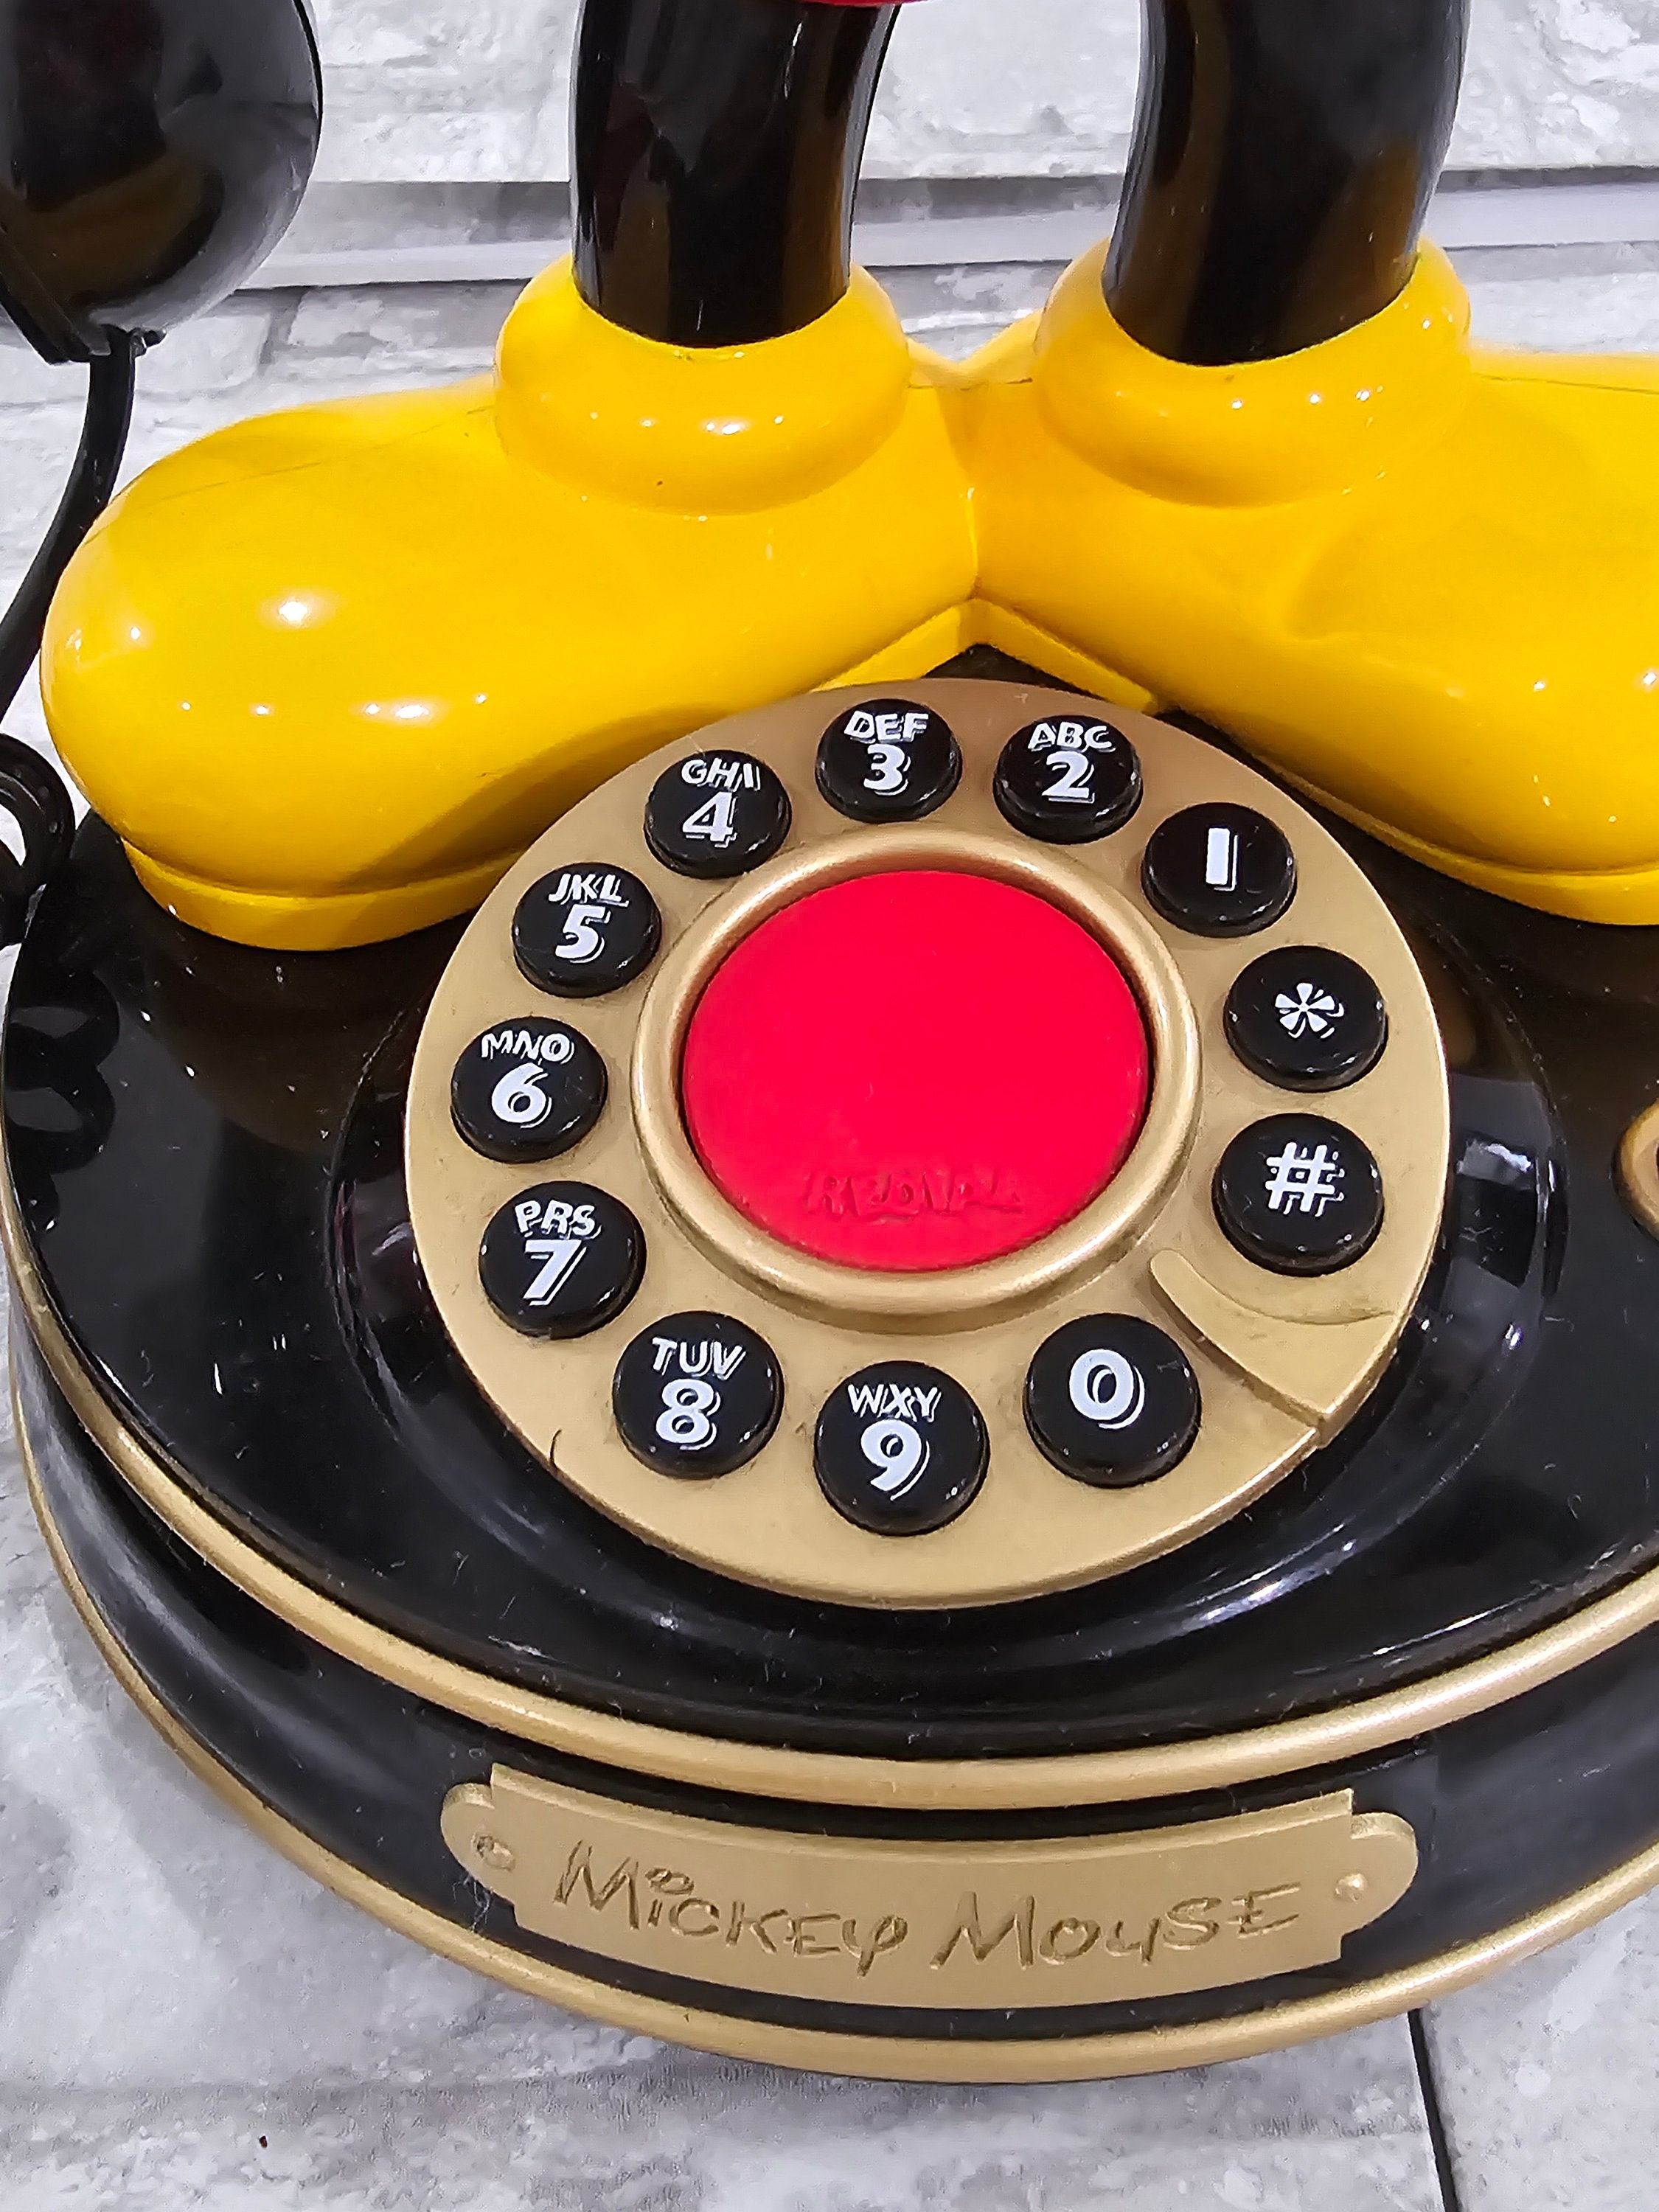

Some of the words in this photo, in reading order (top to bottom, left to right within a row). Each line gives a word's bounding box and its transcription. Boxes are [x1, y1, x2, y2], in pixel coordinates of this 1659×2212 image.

[844, 710, 929, 744] DEF
[1028, 722, 1115, 754] ABC
[682, 758, 762, 793] GHI
[864, 744, 912, 796] 3
[1041, 751, 1096, 804] 2
[682, 792, 737, 848] 4
[549, 873, 630, 908] JKL
[554, 904, 611, 964] 5
[481, 1029, 575, 1065] MNO
[491, 1062, 552, 1129] 6
[515, 1200, 602, 1239] PRS
[524, 1239, 587, 1306] 7
[652, 1337, 747, 1380] TUV
[655, 1379, 722, 1450] 8
[847, 1383, 942, 1423] WXY
[1068, 1349, 1146, 1430] 0
[860, 1419, 931, 1501] 9
